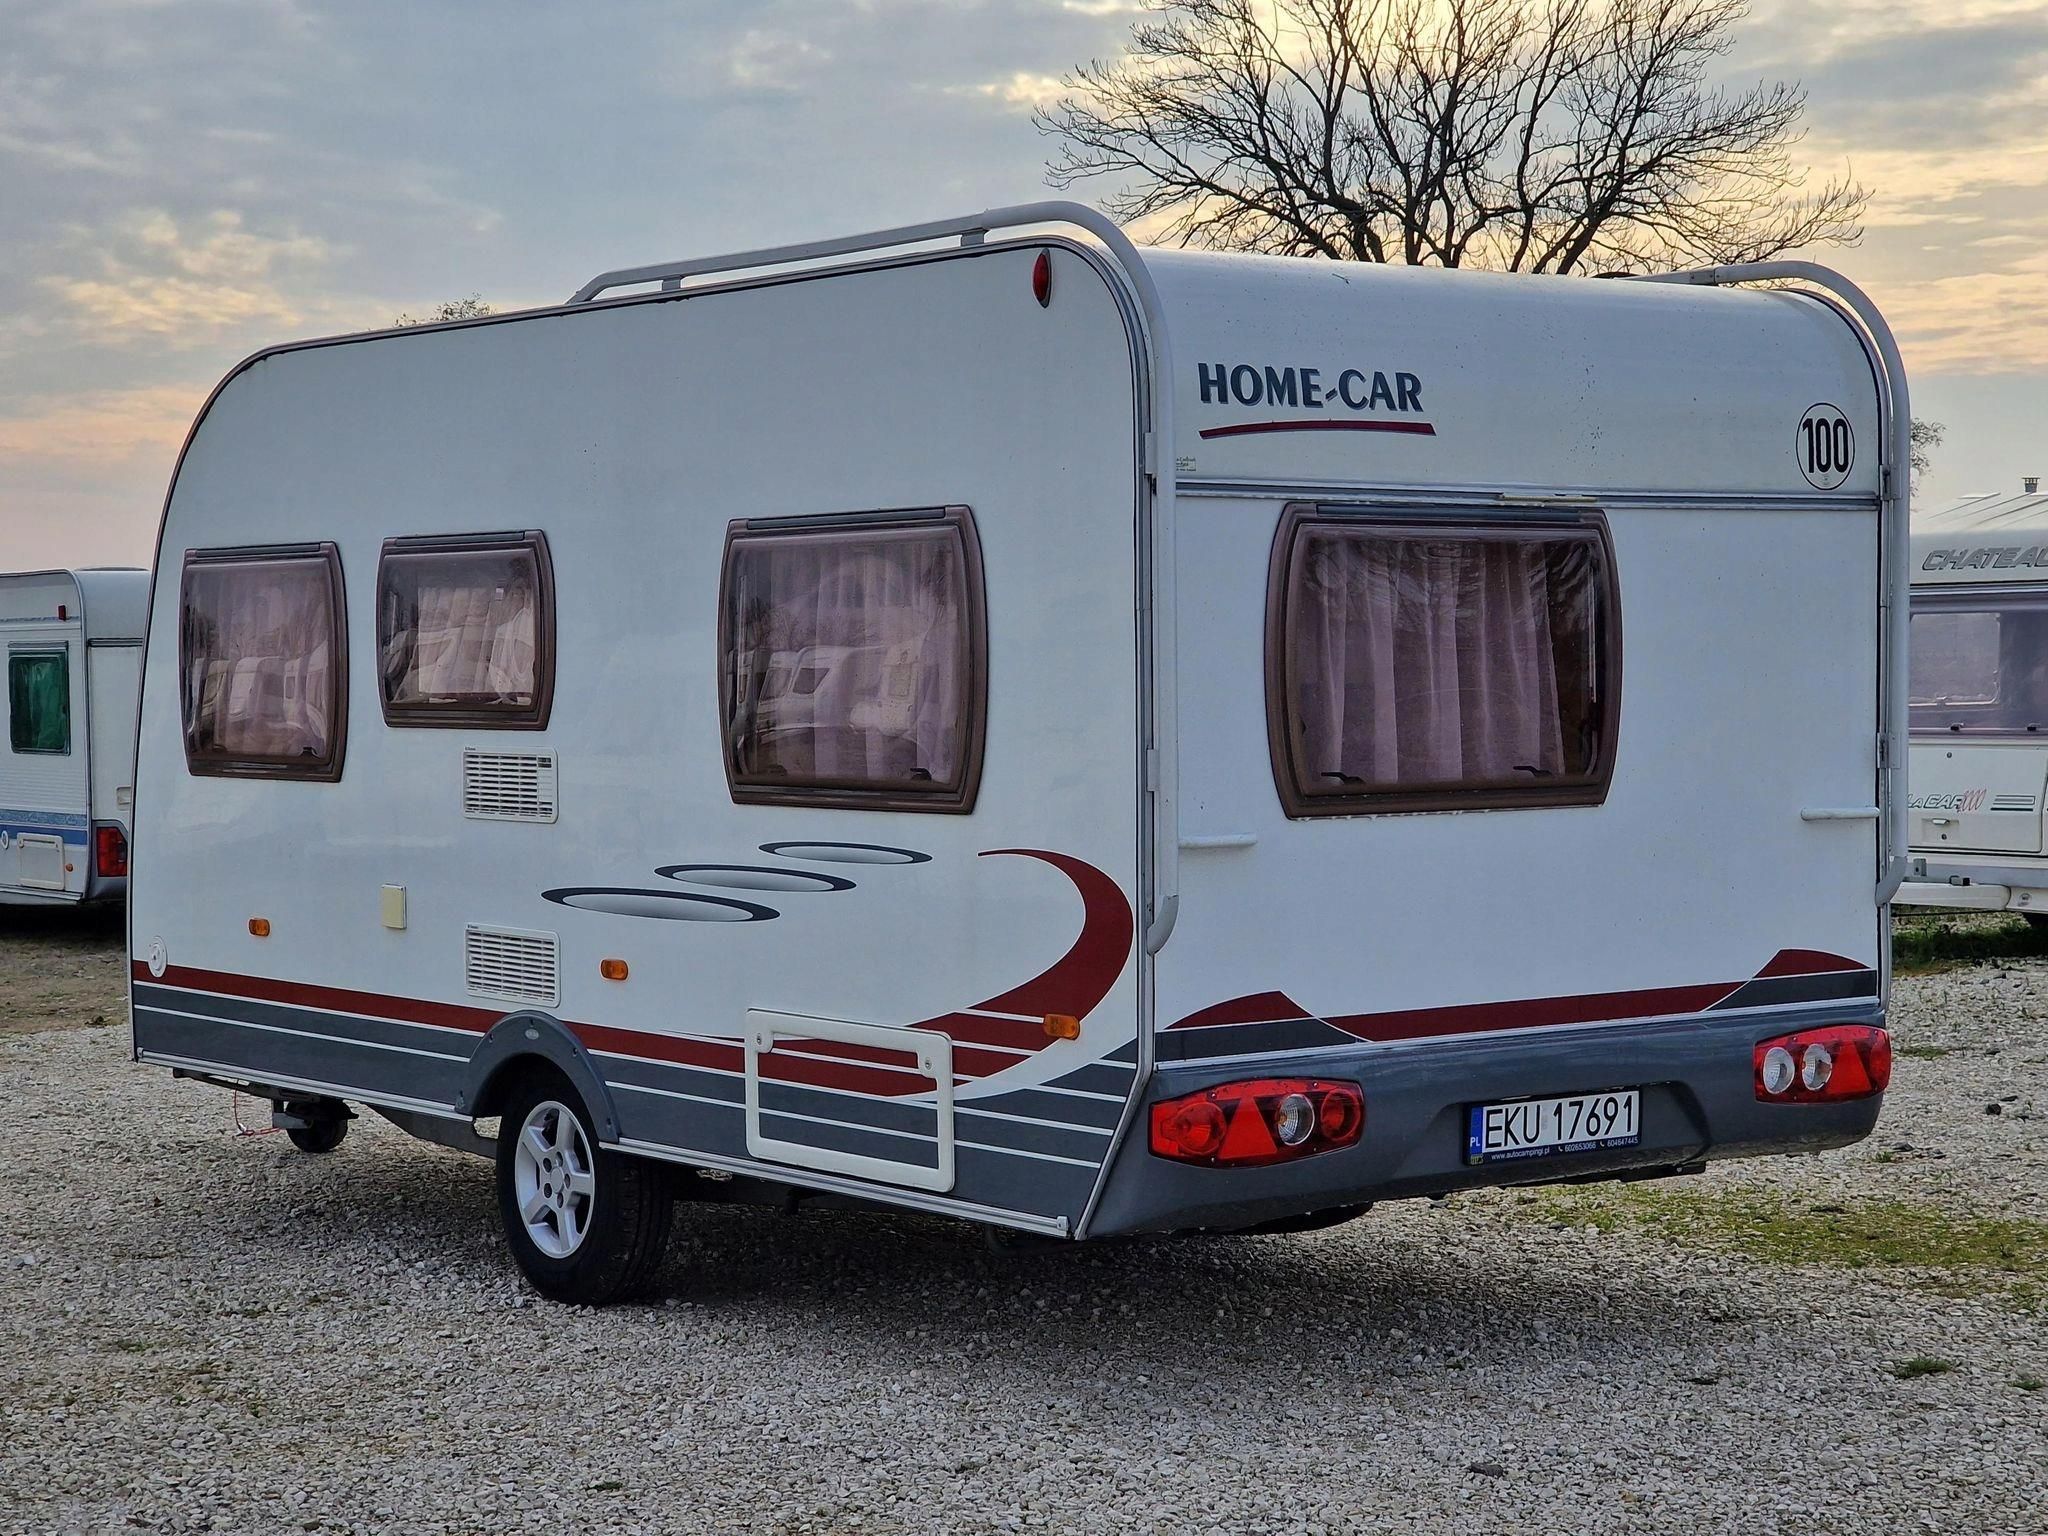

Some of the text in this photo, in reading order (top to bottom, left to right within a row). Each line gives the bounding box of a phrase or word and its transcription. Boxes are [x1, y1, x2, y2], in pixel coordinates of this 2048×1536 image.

[1198, 363, 1424, 412] HOME-CAR
[1802, 418, 1849, 473] 100
[1470, 1137, 1481, 1148] PL
[1485, 1095, 1633, 1149] EKU 17691
